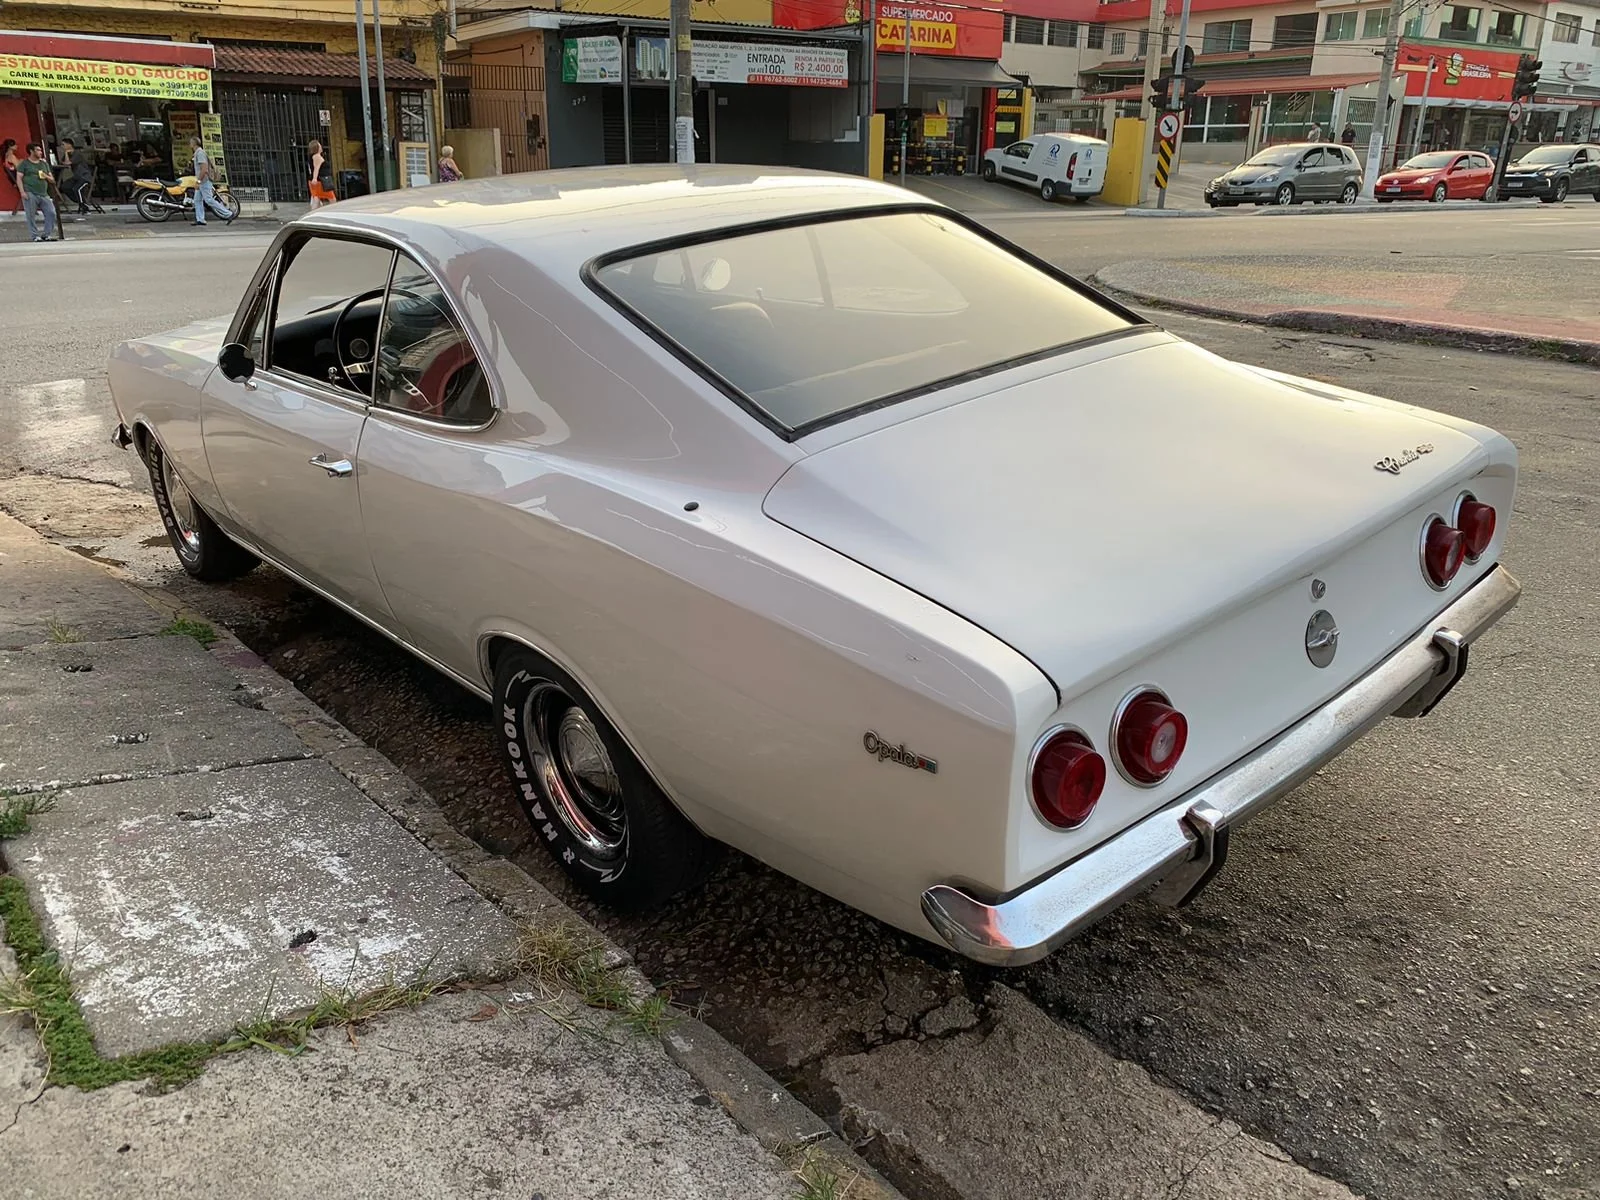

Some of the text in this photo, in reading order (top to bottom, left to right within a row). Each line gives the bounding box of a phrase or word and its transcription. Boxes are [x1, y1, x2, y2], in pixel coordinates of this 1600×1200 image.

[878, 23, 953, 44] CATARINA
[747, 53, 786, 64] ENTRADA
[0, 56, 209, 82] ESTAURANTE DO GAUCHO
[794, 62, 844, 74] R$ 2.400,00
[9, 70, 40, 79] CARNE
[57, 74, 86, 82] BRASA
[87, 76, 116, 84] TODOS
[2, 79, 40, 87] MARMITEX
[45, 82, 81, 90] SERVIMOS
[503, 703, 559, 842] HANKOOK
